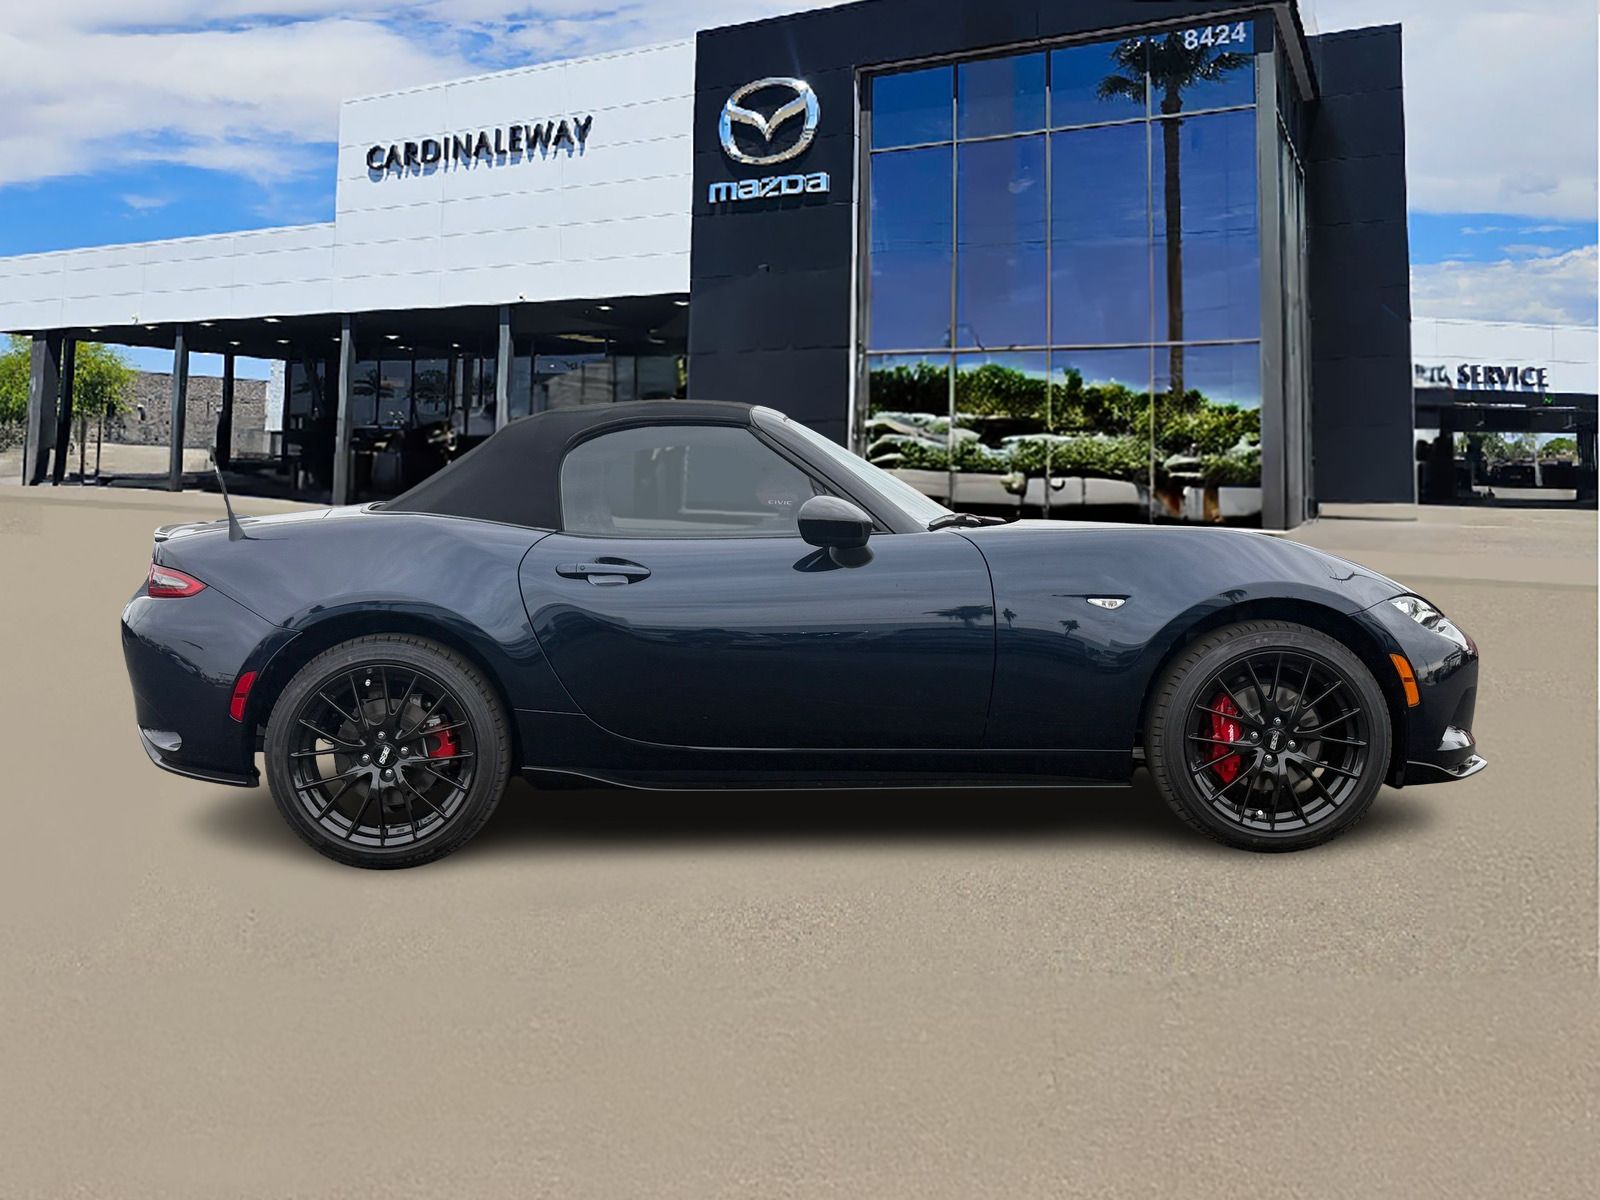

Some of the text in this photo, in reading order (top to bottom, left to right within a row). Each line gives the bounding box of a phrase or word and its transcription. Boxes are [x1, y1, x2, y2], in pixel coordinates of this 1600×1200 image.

[1184, 22, 1247, 50] 8424
[366, 115, 593, 171] CARDINALEWAY
[1456, 363, 1549, 388] SERVICE
